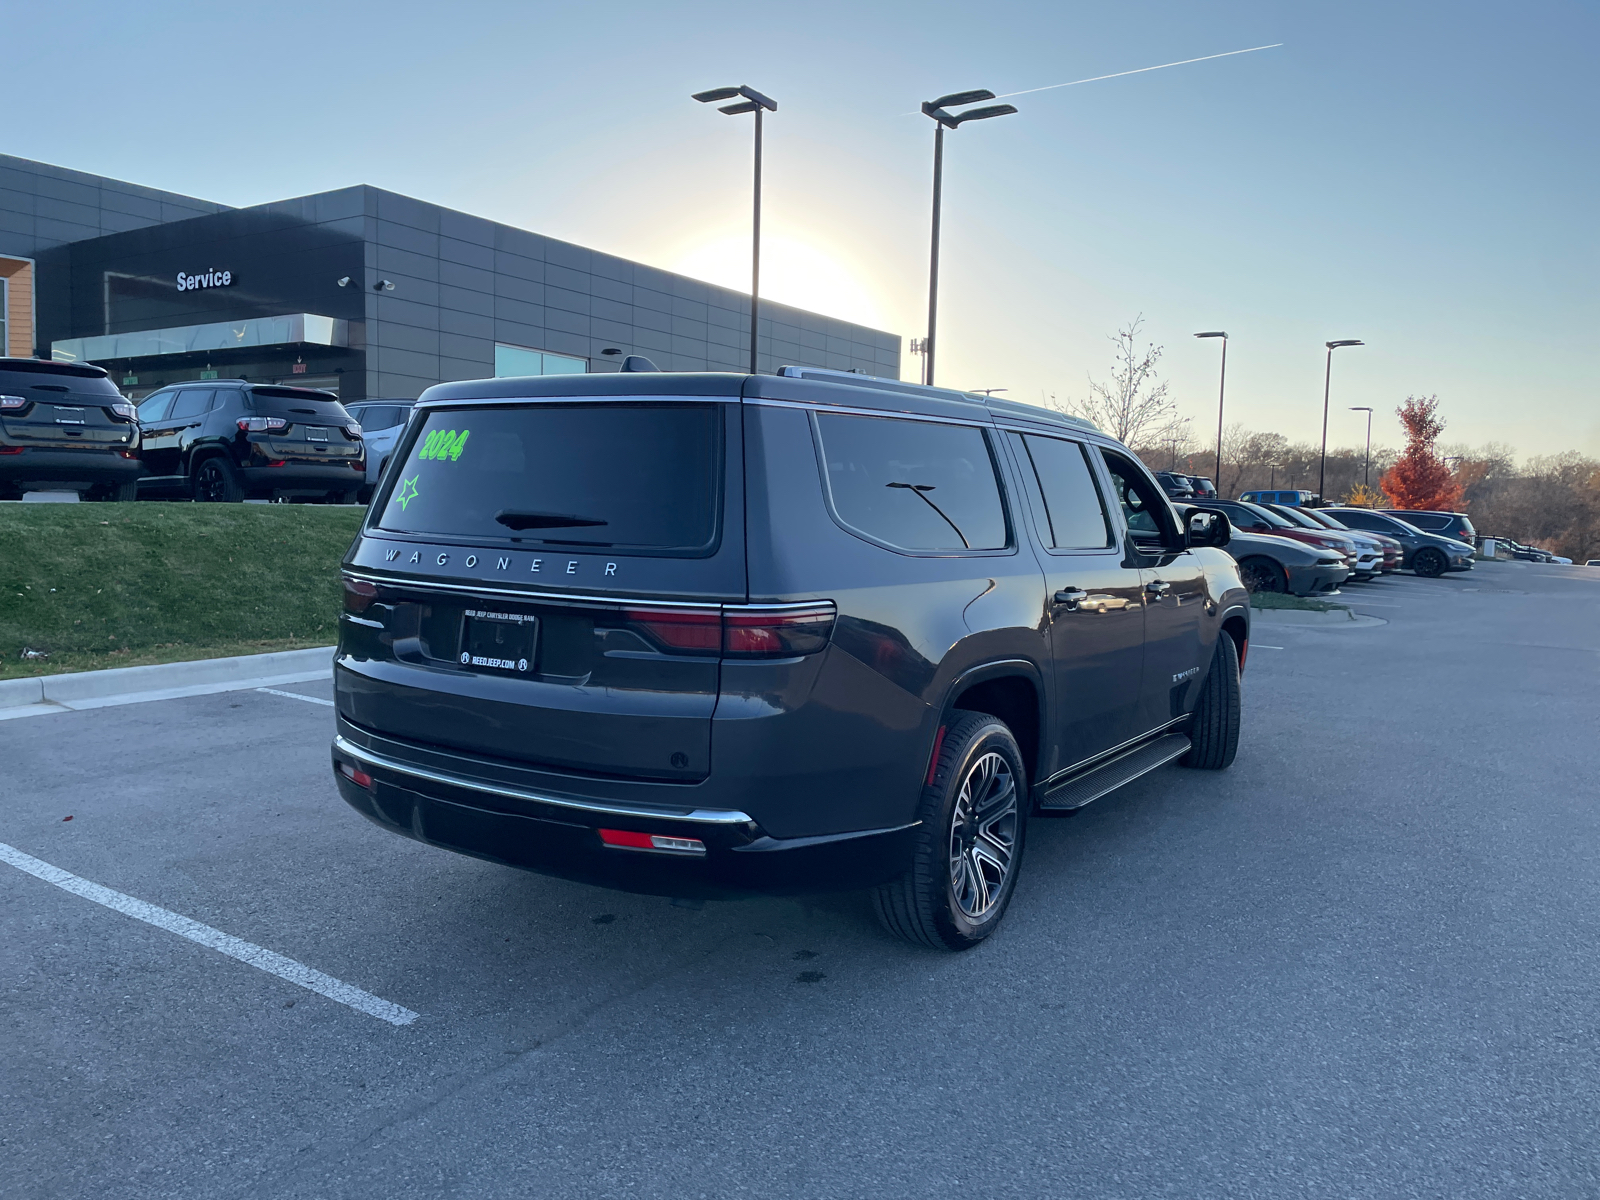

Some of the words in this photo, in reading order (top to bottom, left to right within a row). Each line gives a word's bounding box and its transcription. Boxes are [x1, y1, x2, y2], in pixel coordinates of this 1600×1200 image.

[177, 267, 231, 291] Service
[418, 429, 470, 461] 2024
[385, 549, 617, 576] WAGONEER
[487, 612, 508, 620] CHRYSLER
[508, 614, 523, 622] DODGE
[471, 656, 515, 669] REEDJEEP.COM
